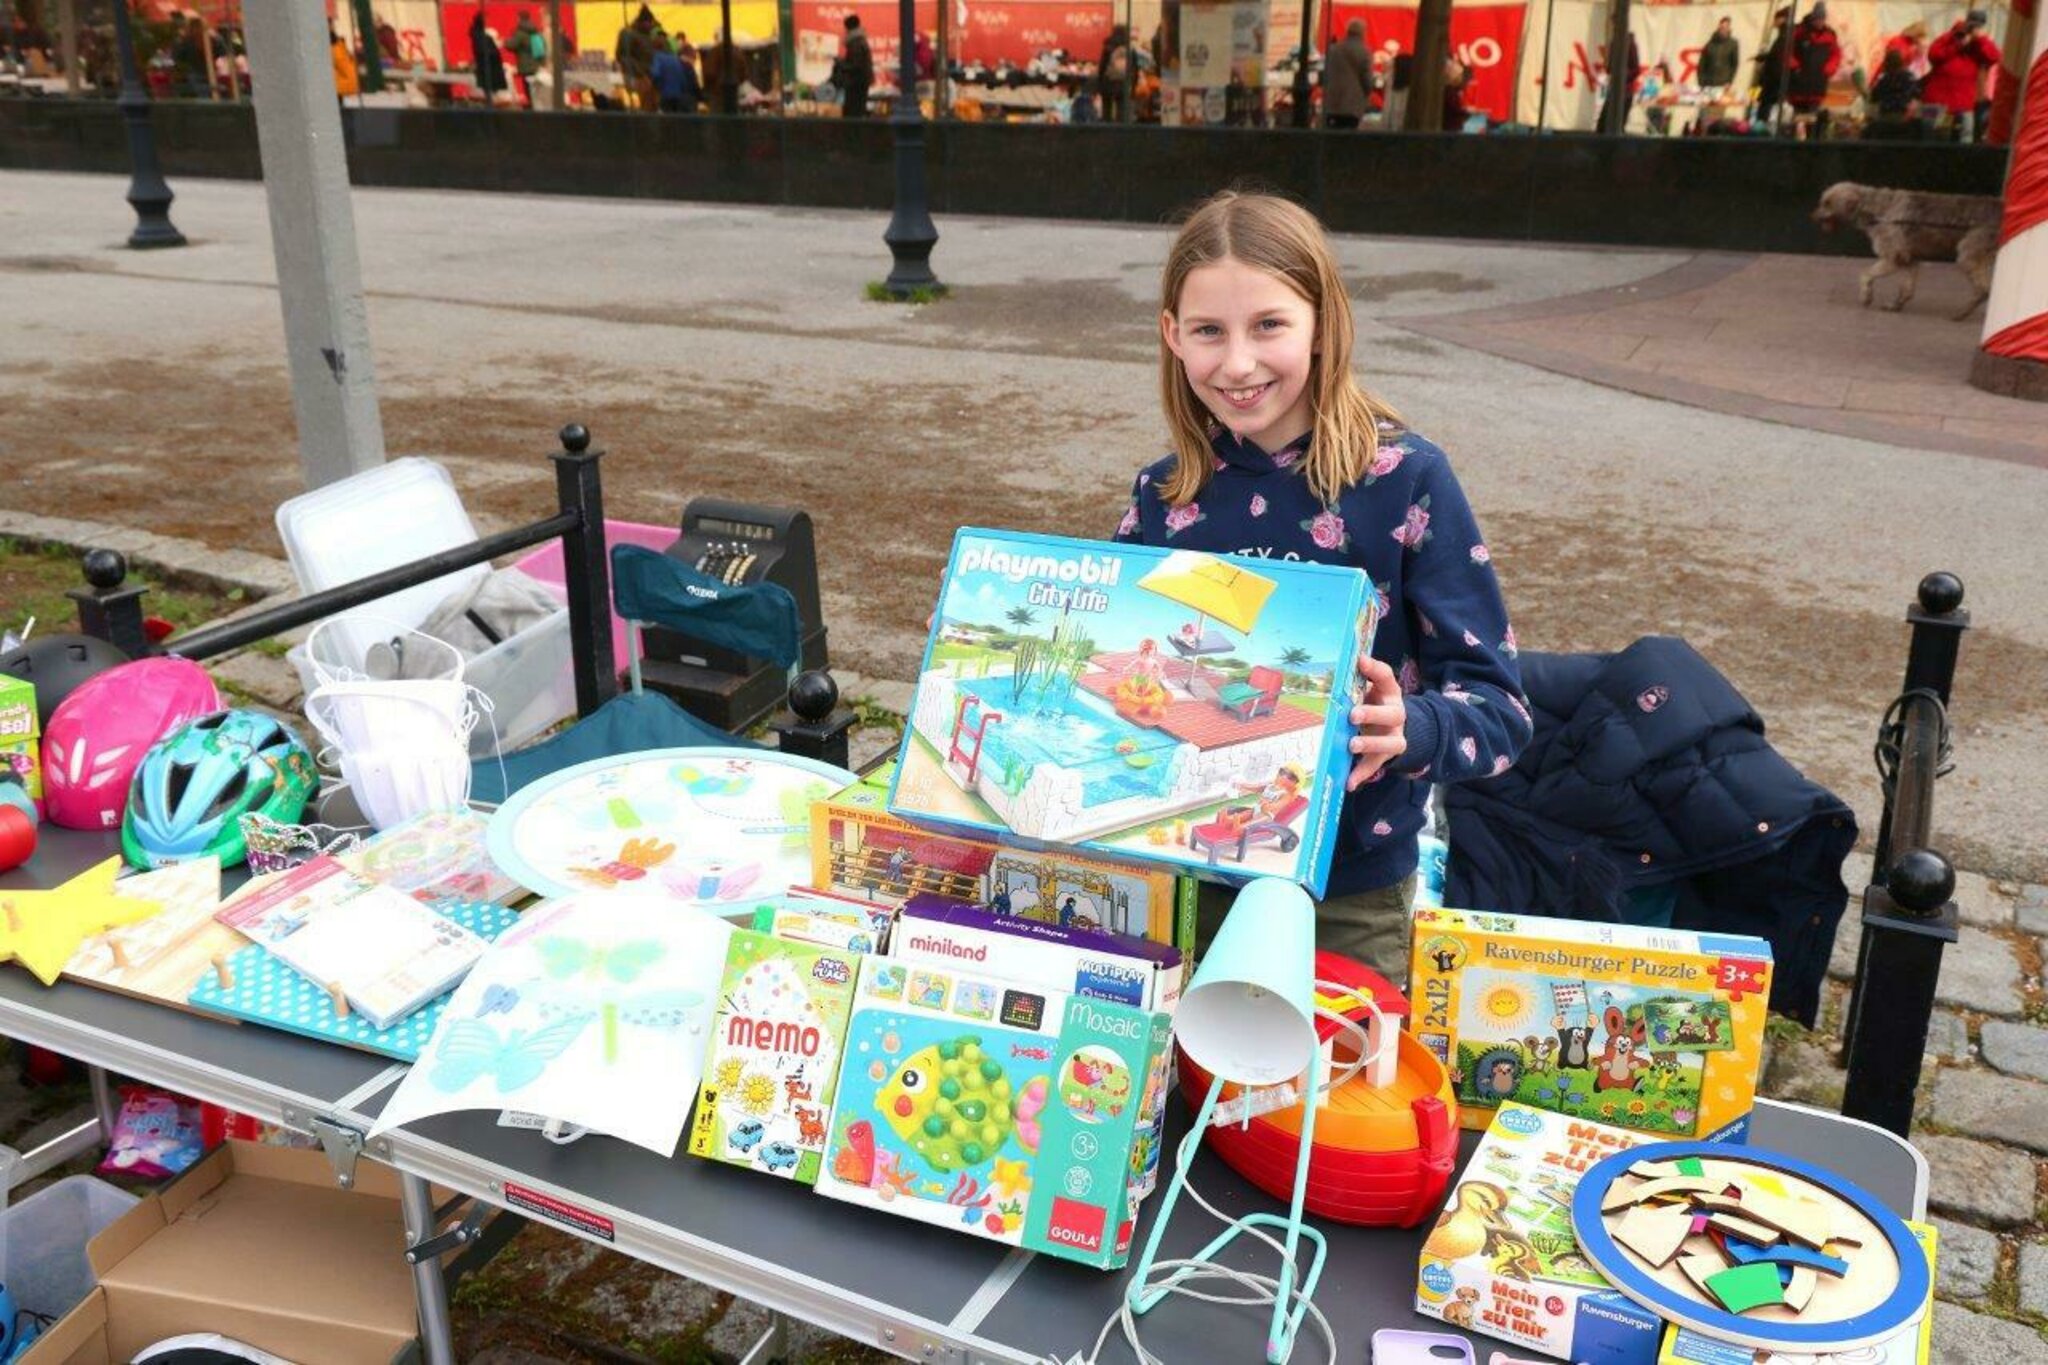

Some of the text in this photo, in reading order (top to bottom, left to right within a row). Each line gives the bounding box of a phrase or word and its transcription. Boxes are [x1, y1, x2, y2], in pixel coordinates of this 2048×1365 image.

[958, 544, 1122, 586] playmobil
[1028, 581, 1109, 612] City Life
[993, 918, 1069, 939] Activity Shapes
[910, 936, 987, 962] miniland
[1485, 941, 1625, 974] Ravensburger
[1631, 957, 1697, 980] Puzzle
[1723, 965, 1749, 983] 3+
[1424, 979, 1450, 1028] 2x12
[728, 1016, 820, 1057] memo
[1074, 1136, 1095, 1156] 3+
[1542, 1152, 1588, 1173] zu
[1051, 1226, 1097, 1248] GOULA
[1491, 1280, 1539, 1307] Mein
[1492, 1295, 1536, 1321] Tier
[1581, 1302, 1655, 1332] Ravensburger
[1482, 1309, 1508, 1328] zu
[1511, 1319, 1550, 1340] mir
